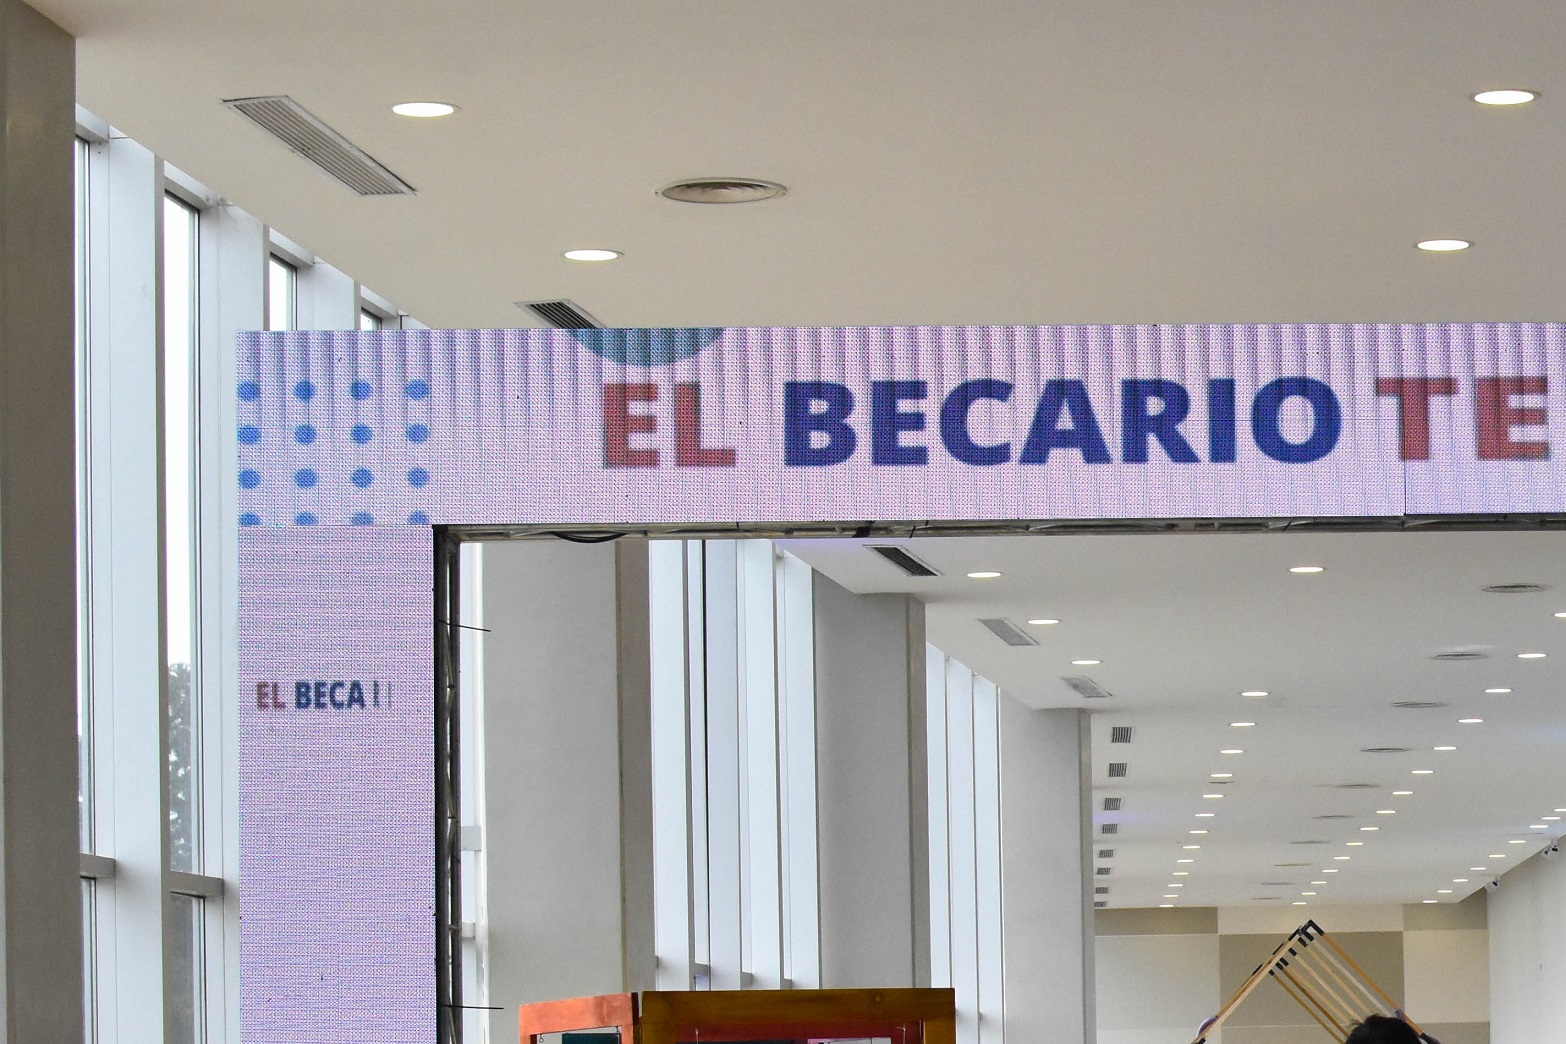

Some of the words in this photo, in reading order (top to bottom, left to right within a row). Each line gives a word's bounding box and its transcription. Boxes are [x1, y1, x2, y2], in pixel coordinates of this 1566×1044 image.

[601, 381, 736, 468] EL
[782, 375, 1342, 468] BECARIO
[1376, 374, 1550, 462] TE
[256, 680, 286, 711] EL
